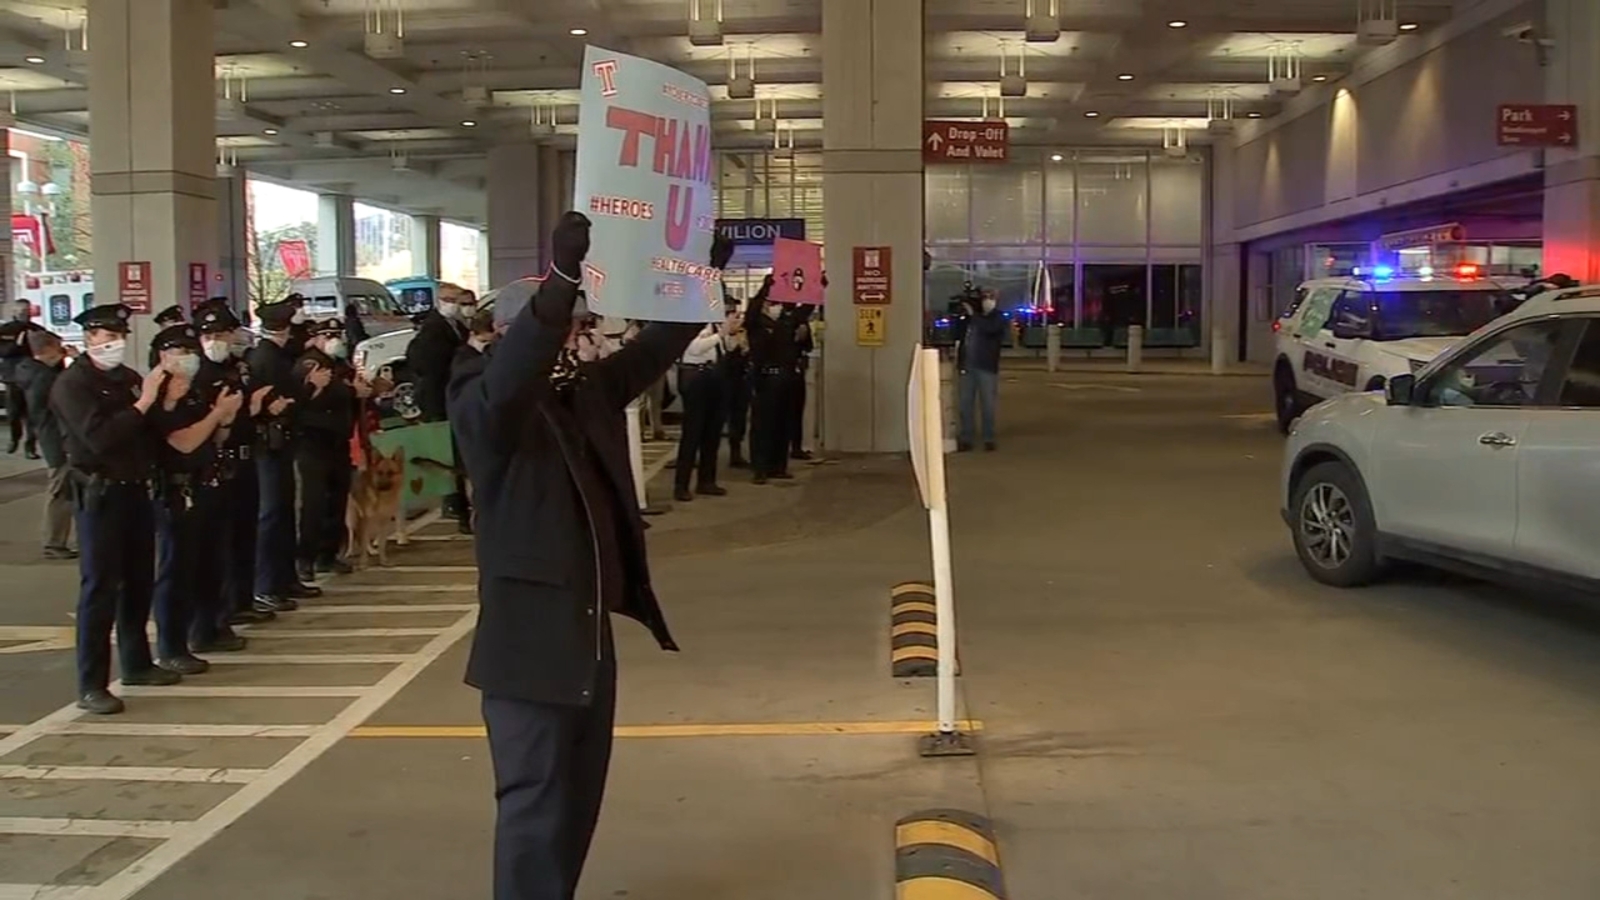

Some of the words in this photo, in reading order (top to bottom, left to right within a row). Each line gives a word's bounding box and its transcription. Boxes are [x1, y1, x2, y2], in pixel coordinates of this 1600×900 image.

[1502, 108, 1533, 121] Park
[948, 126, 1005, 142] Drop-Off
[606, 105, 711, 185] THAN
[946, 144, 971, 158] And
[974, 144, 1005, 158] Valet
[589, 195, 655, 221] #HEROES
[665, 184, 694, 251] U
